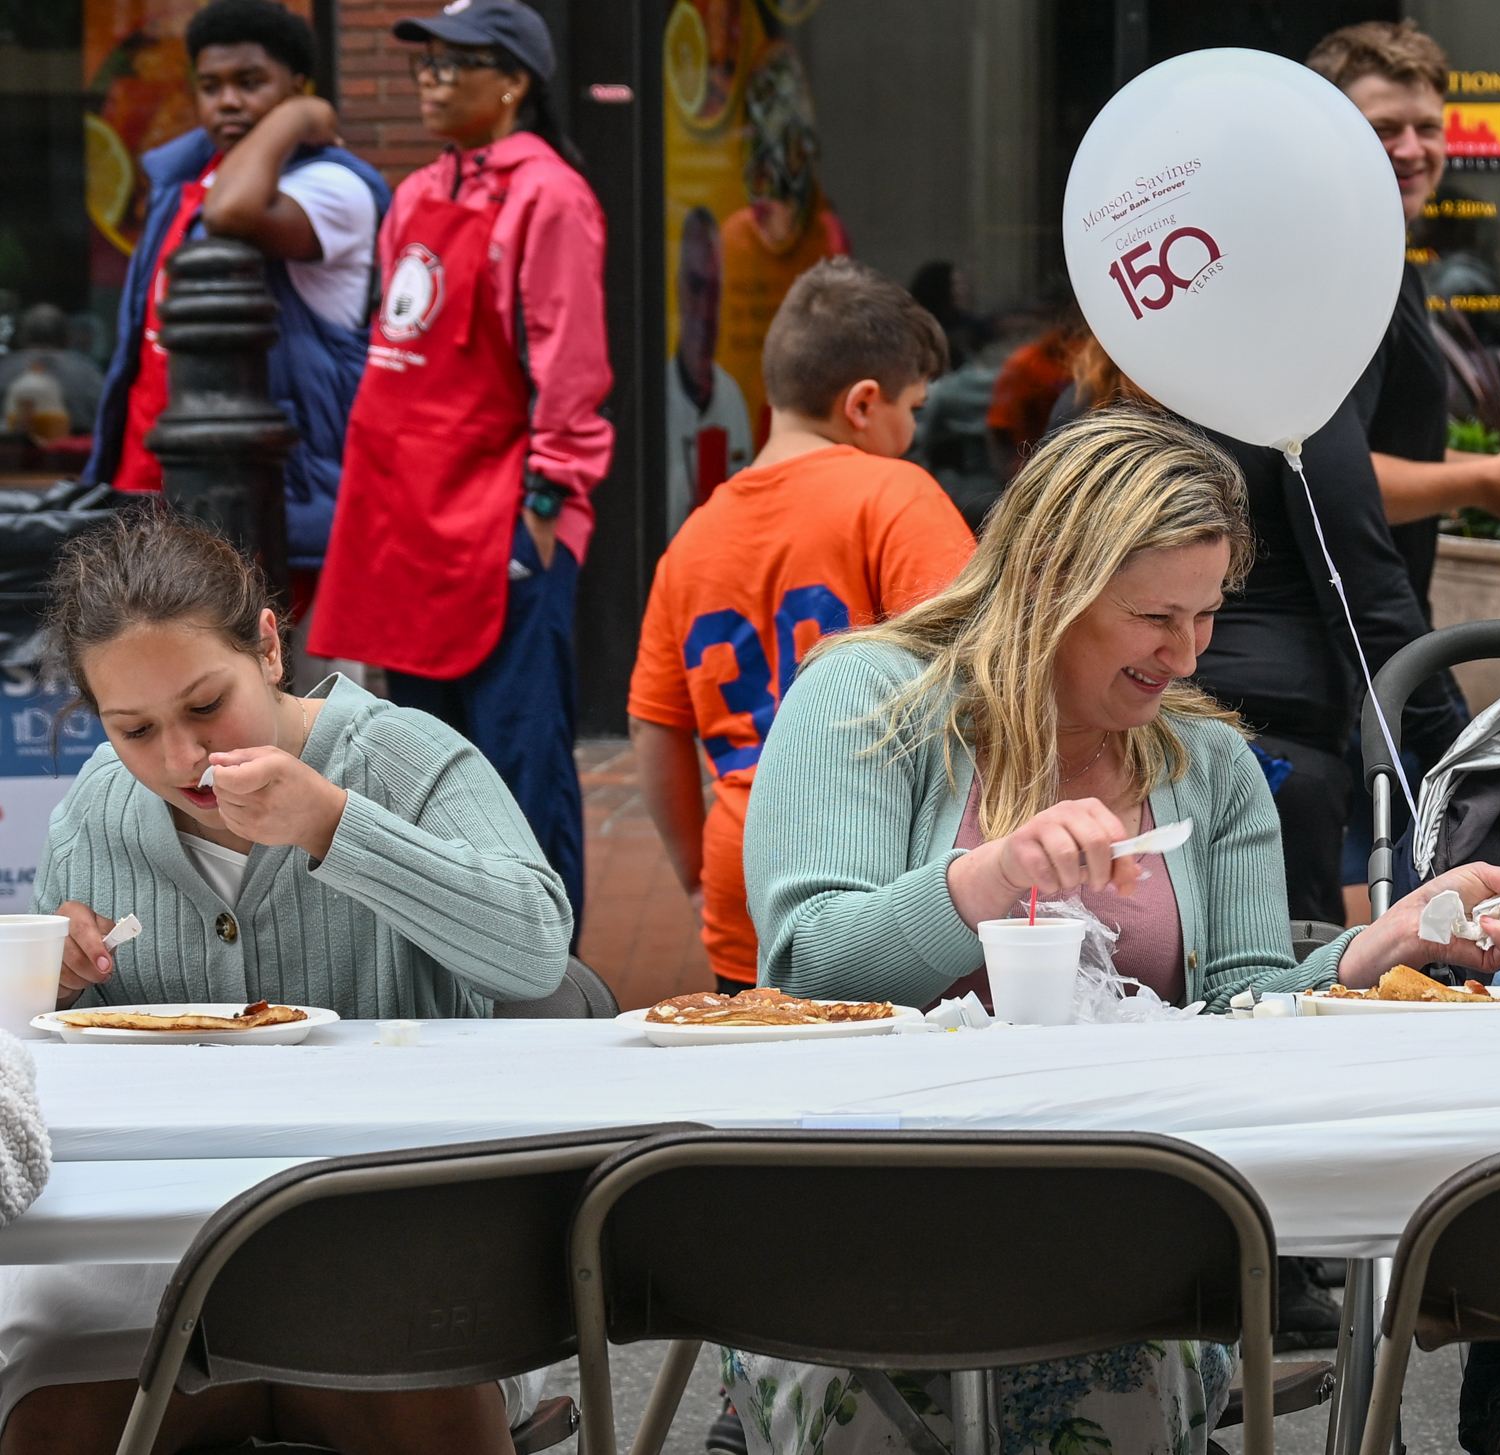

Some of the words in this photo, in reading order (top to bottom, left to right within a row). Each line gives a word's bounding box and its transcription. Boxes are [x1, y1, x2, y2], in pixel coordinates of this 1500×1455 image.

[1082, 190, 1133, 232] Monson
[1135, 157, 1202, 195] Savings
[1111, 209, 1128, 222] Your
[1129, 195, 1151, 212] Bank
[1152, 180, 1186, 199] Forever
[1115, 213, 1177, 251] Celebrating
[1108, 226, 1221, 320] 150
[1190, 261, 1224, 295] YEARS
